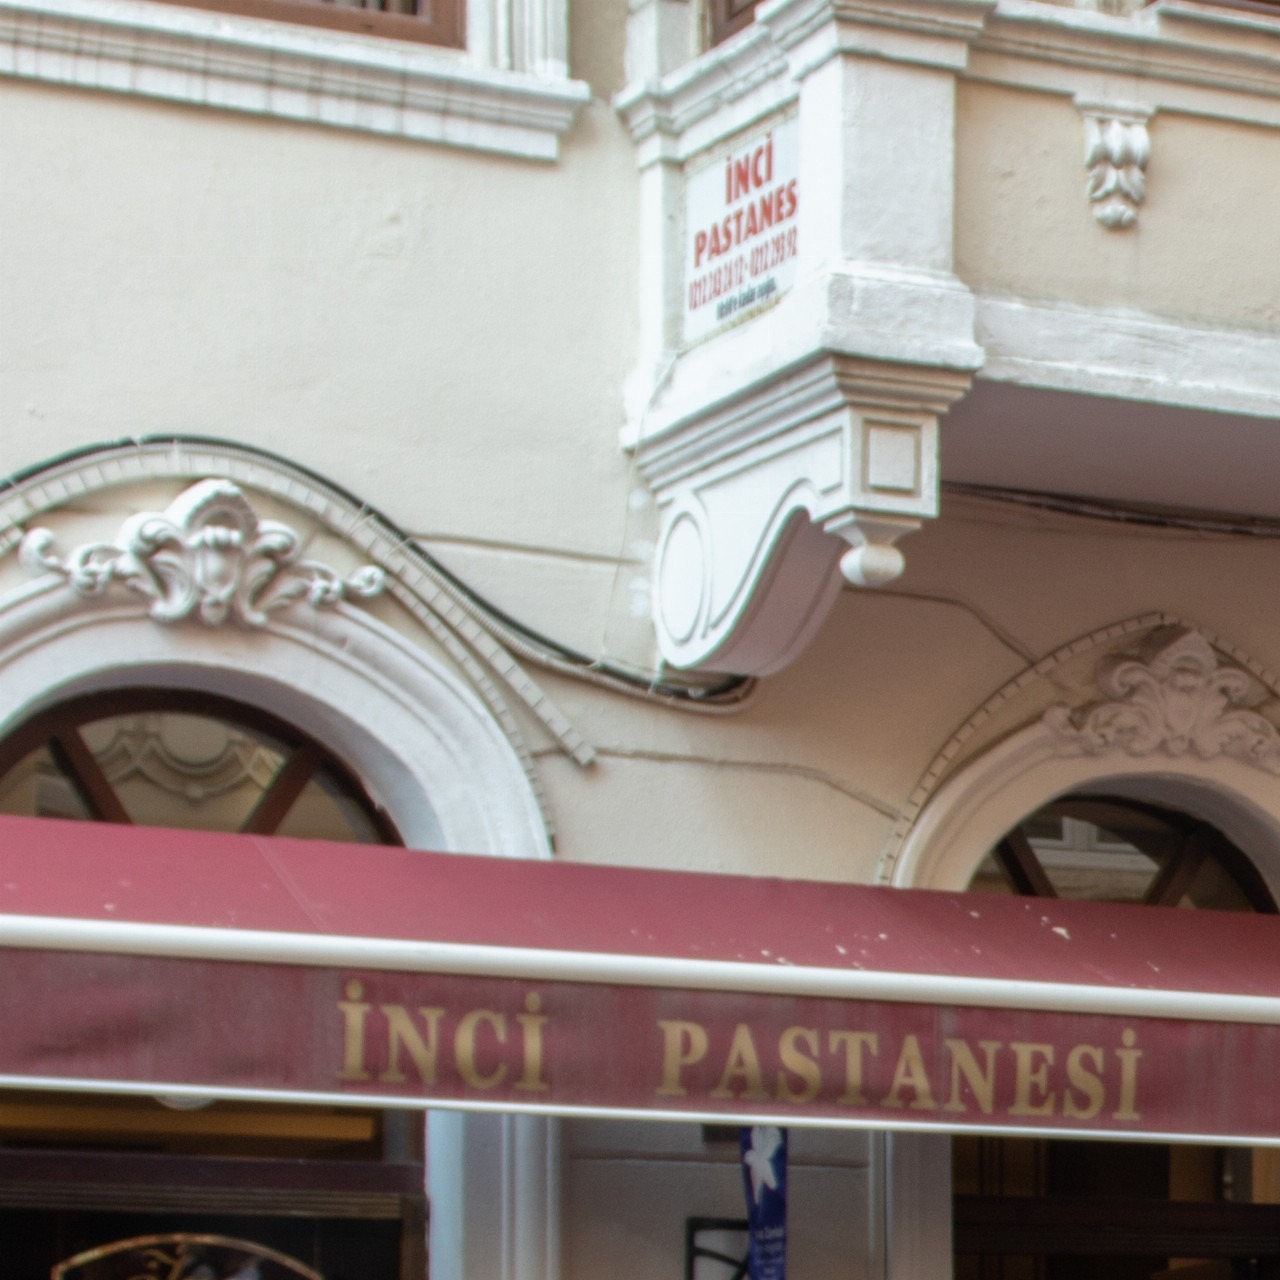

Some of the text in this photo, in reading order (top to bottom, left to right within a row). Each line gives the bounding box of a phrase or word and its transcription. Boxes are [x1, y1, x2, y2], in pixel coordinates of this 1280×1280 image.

[725, 130, 773, 205] İNCİ
[694, 178, 798, 269] PASTANES
[335, 979, 1143, 1121] İNCİ PASTANESİ
